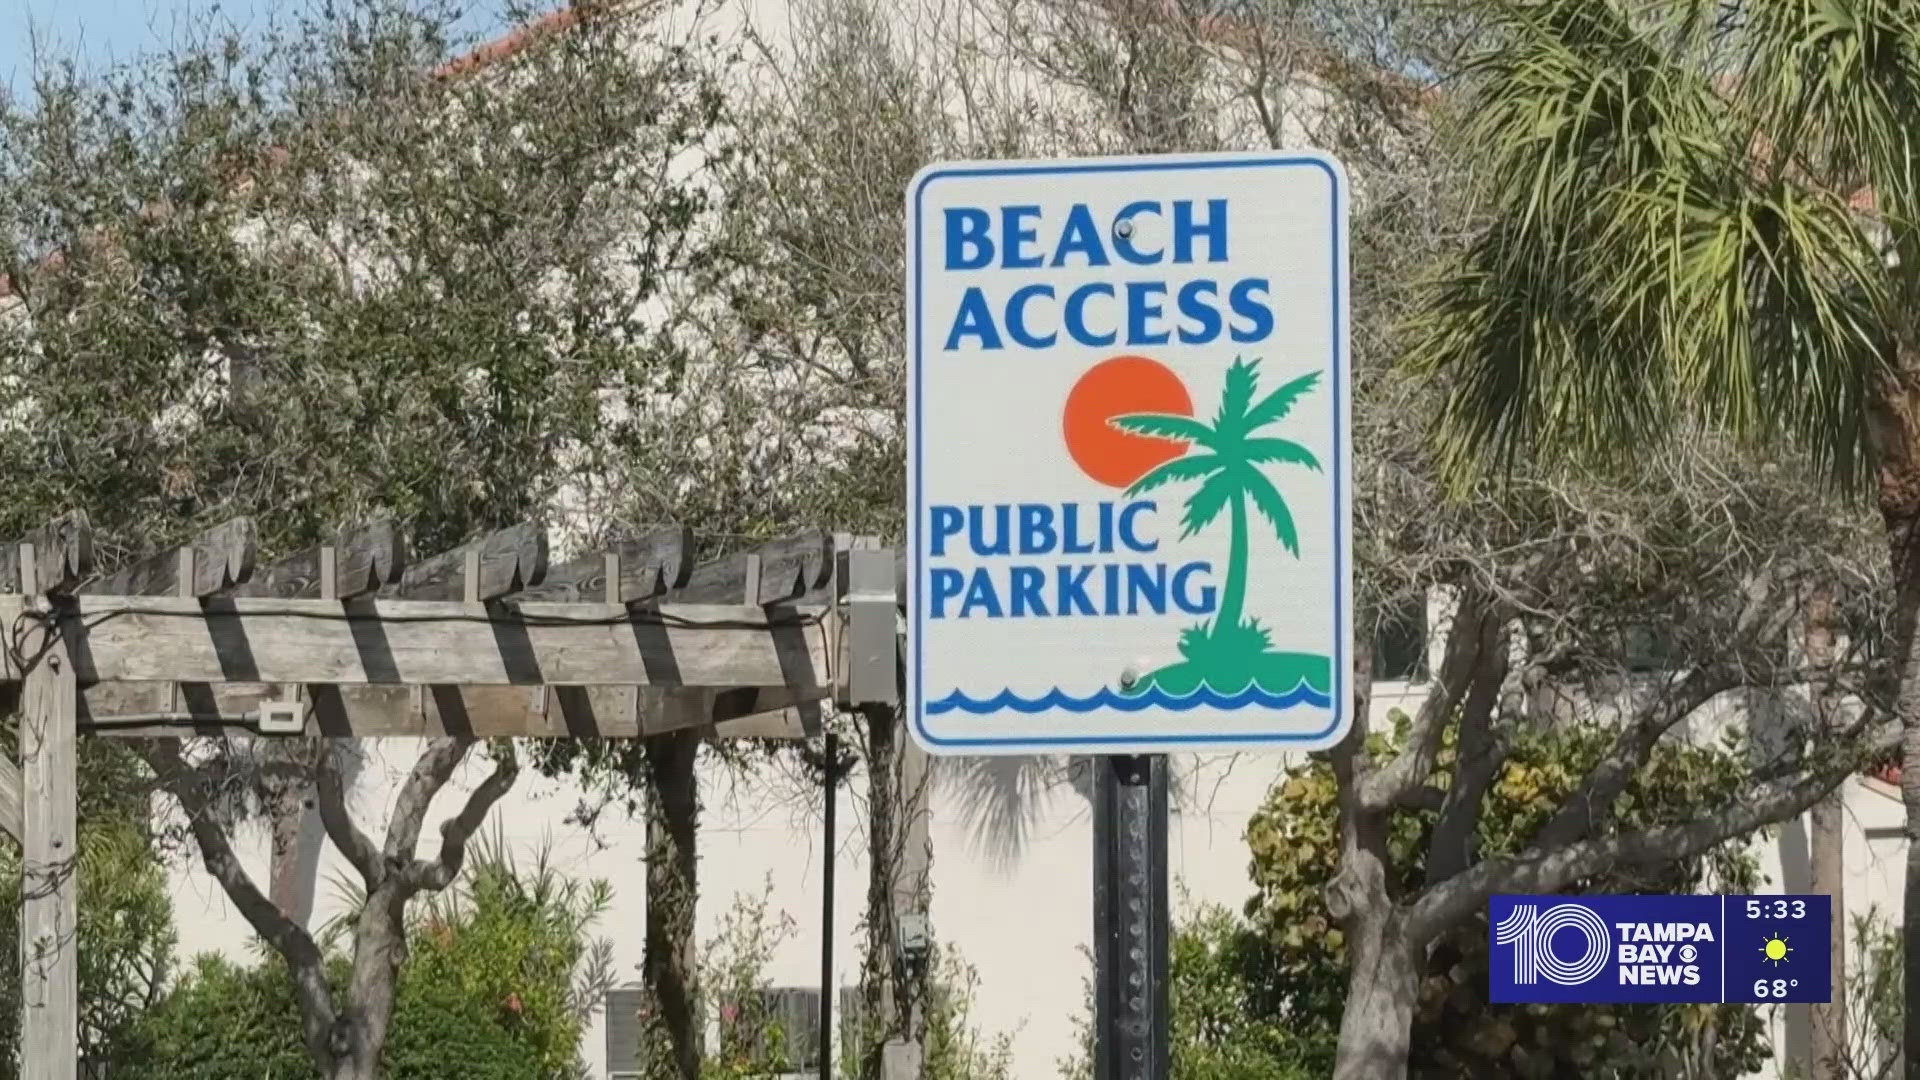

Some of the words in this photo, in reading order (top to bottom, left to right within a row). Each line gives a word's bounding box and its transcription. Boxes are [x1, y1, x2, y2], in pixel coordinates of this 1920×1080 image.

[943, 199, 1229, 271] BEACH
[943, 278, 1274, 351] ACCESS
[929, 501, 1159, 557] PUBLIC
[929, 562, 1217, 619] PARKING
